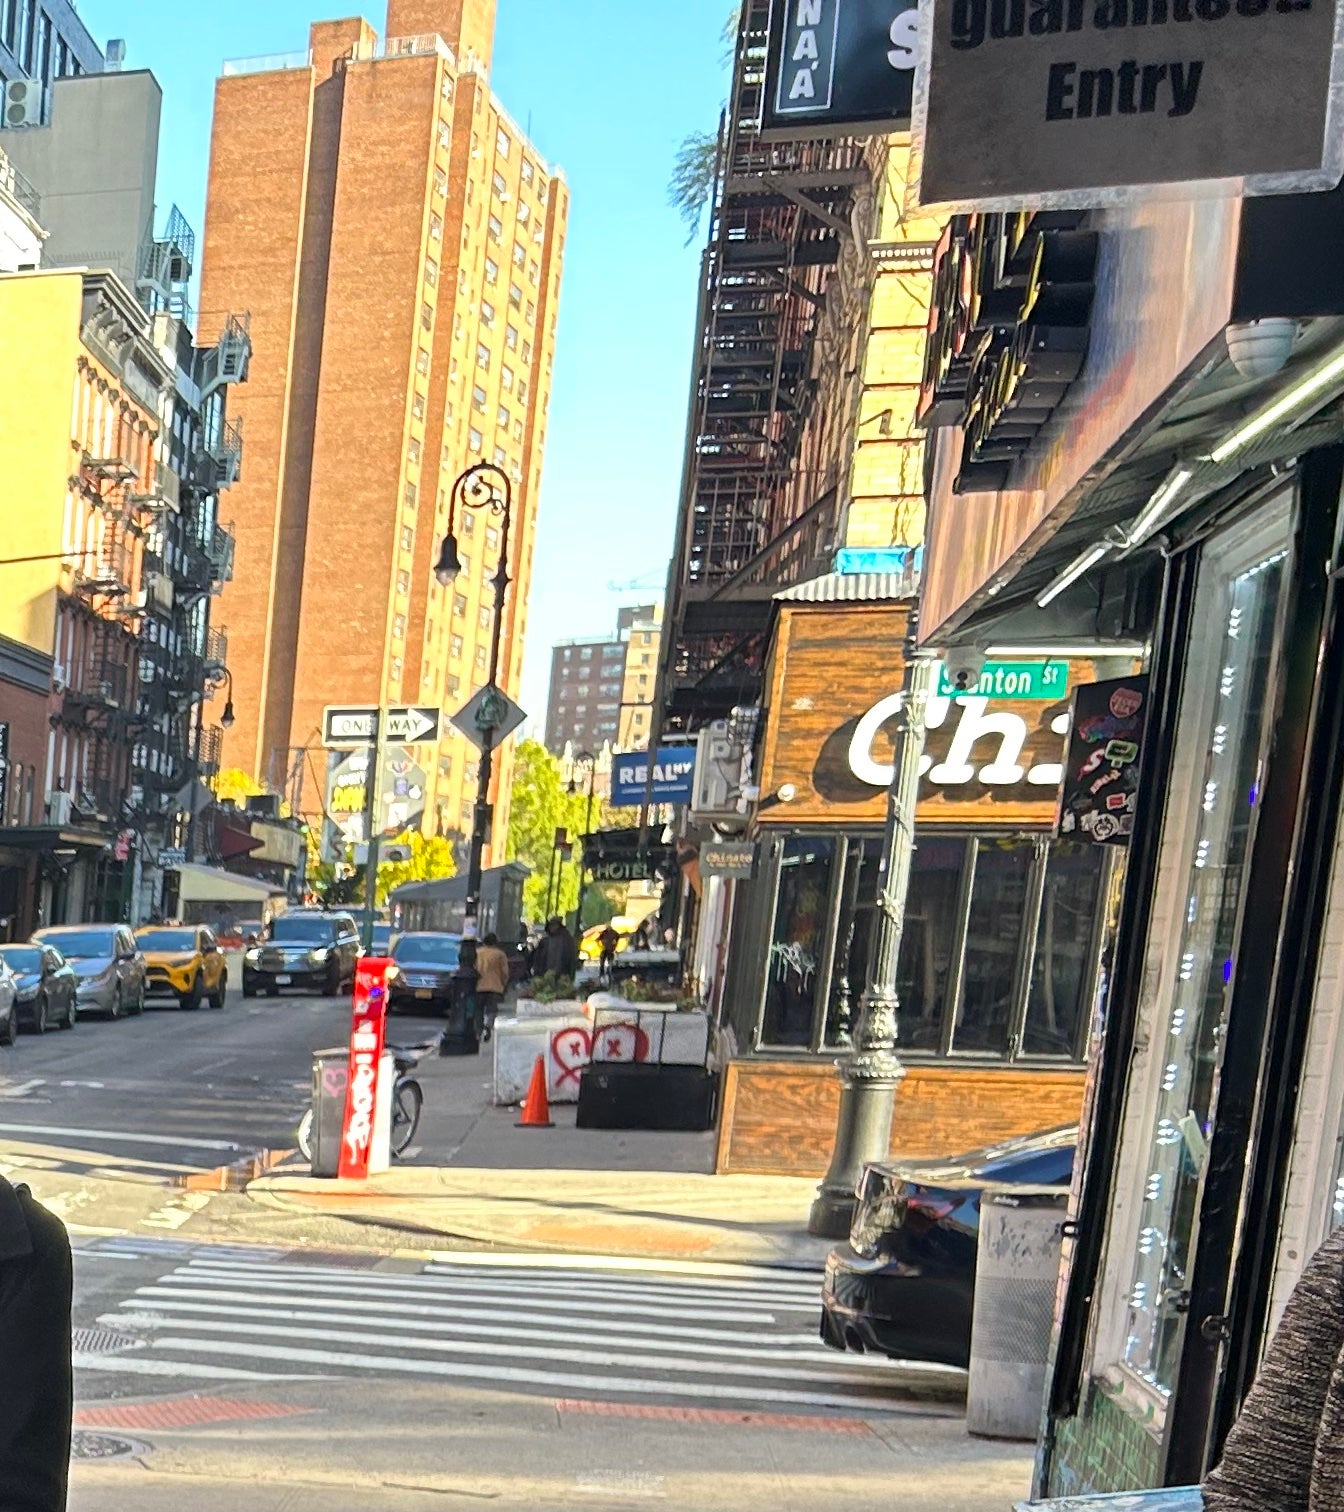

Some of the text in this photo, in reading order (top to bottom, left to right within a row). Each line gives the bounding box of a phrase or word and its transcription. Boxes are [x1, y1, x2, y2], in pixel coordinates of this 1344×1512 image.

[949, 0, 1313, 51] guaran
[1045, 58, 1206, 121] Entry
[941, 665, 1059, 695] Snton St
[389, 719, 423, 731] WAY
[597, 862, 653, 880] HOTEL
